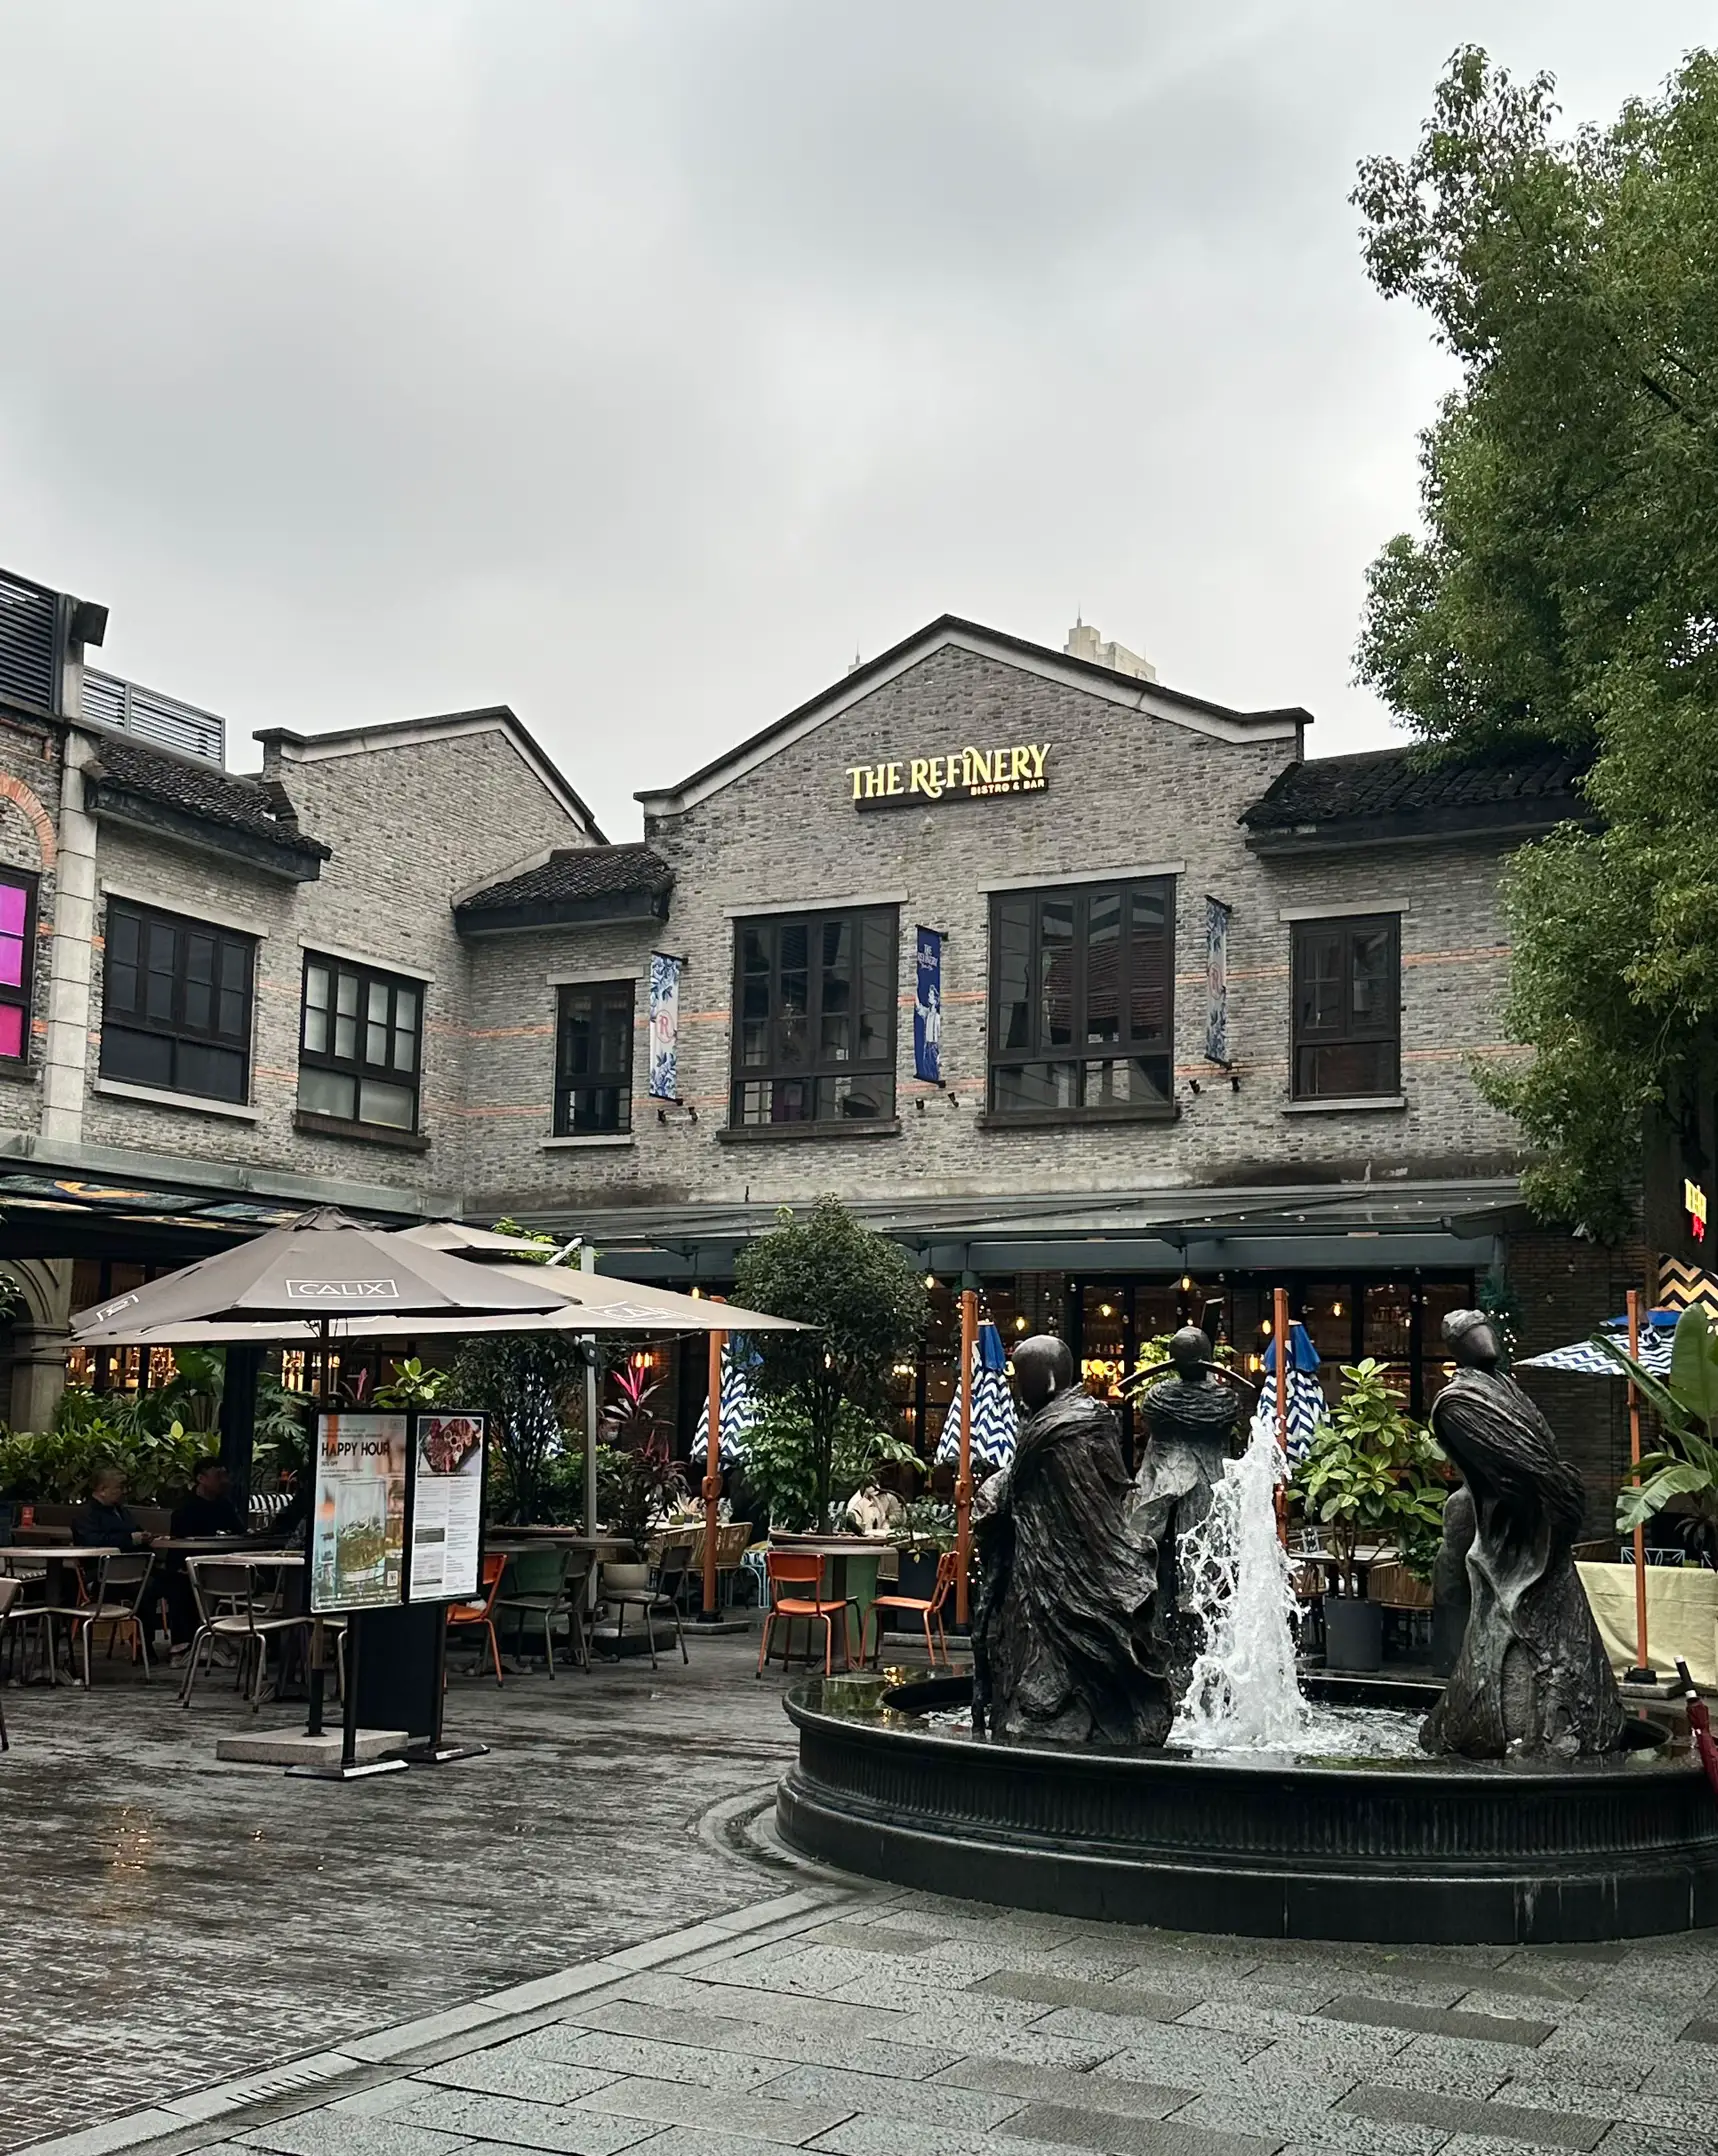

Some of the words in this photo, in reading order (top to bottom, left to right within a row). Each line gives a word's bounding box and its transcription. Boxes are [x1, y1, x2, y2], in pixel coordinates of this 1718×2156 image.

[846, 762, 904, 800] THE
[909, 743, 1051, 799] REFINERY
[970, 783, 1010, 796] BISTRO
[1012, 781, 1020, 791] &
[1023, 779, 1045, 790] BAR
[659, 1015, 672, 1039] R
[298, 1283, 386, 1295] CALIX
[321, 1441, 358, 1457] HAPPY
[361, 1441, 390, 1457] HOUR
